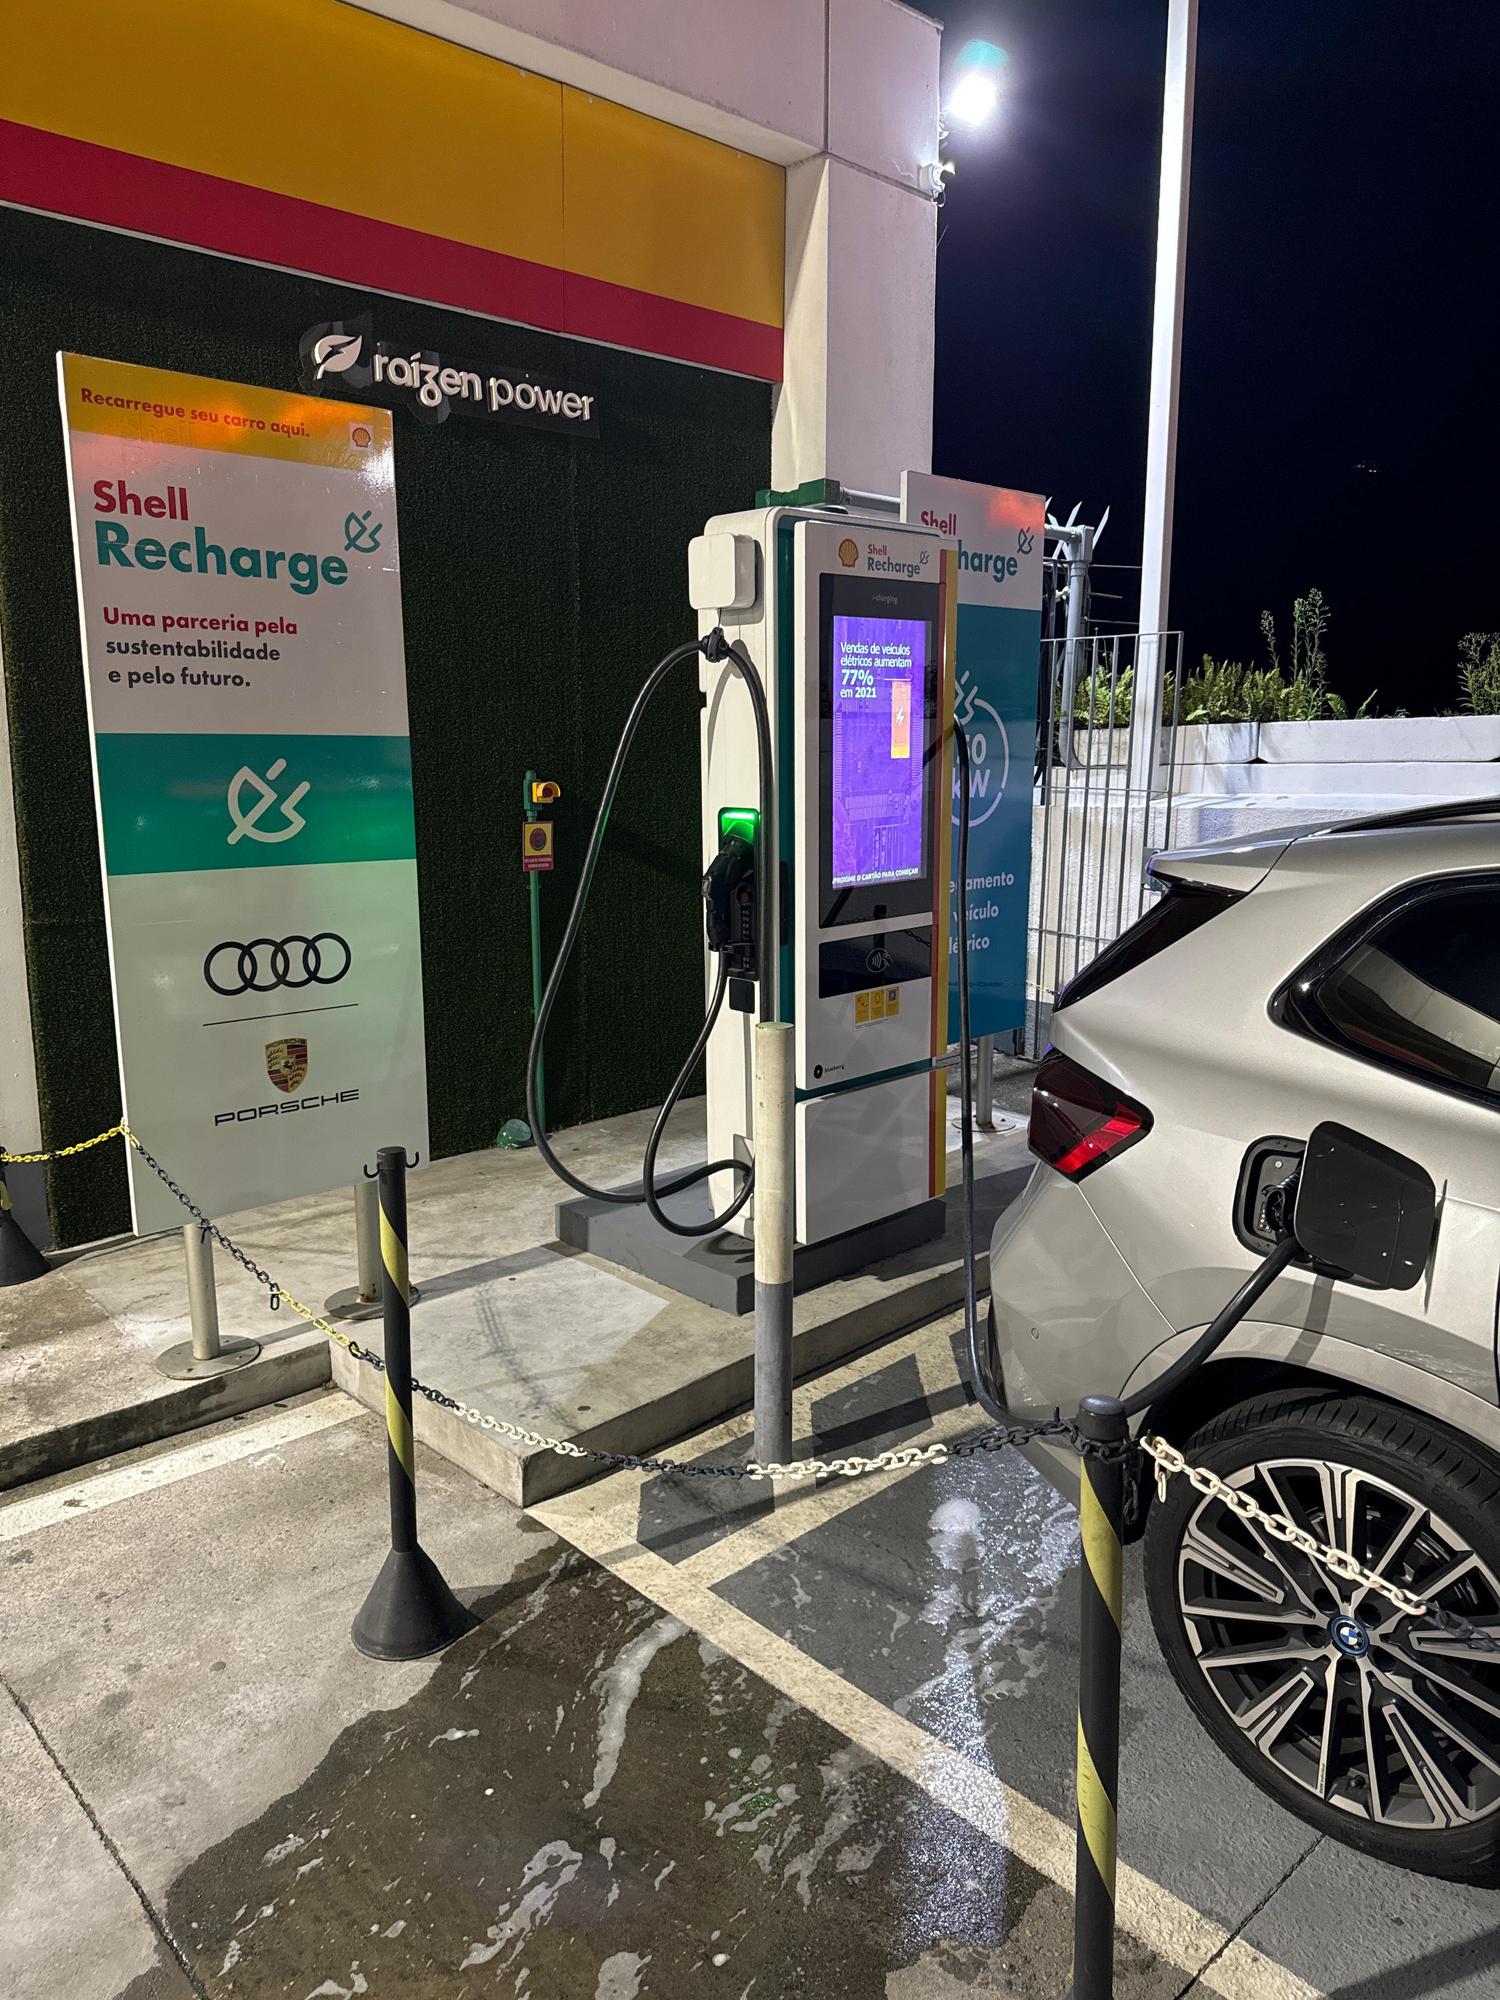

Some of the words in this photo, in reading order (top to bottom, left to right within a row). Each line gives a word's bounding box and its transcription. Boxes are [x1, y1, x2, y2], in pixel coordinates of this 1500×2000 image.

[373, 352, 483, 407] raízen
[487, 376, 594, 421] power
[81, 388, 185, 418] Recarregue
[190, 408, 218, 424] seu
[223, 413, 266, 430] carro
[270, 420, 310, 438] aqui.
[93, 480, 189, 521] Shell
[921, 511, 957, 536] Shell
[95, 520, 348, 595] Recharge
[868, 544, 888, 556] Shell
[957, 539, 1018, 583] harge
[868, 556, 920, 578] Recharge
[103, 607, 156, 626] Uma
[162, 614, 249, 632] parceria
[255, 617, 298, 637] pela
[106, 640, 281, 660] sustentabilidade
[840, 642, 869, 654] Vendas
[870, 643, 880, 654] de
[882, 643, 911, 655] veículos
[840, 654, 873, 666] elétricos
[874, 656, 912, 667] aumentam
[108, 670, 121, 683] e
[128, 666, 175, 688] pelo
[181, 667, 251, 687] futuro.
[841, 669, 874, 685] 77%
[840, 688, 853, 698] em
[855, 687, 877, 698] 2021
[833, 875, 856, 884] PROXIME
[882, 870, 895, 878] PARA
[949, 872, 1014, 893] eamento
[948, 933, 990, 954] lérico
[215, 1089, 360, 1126] PORSCHE
